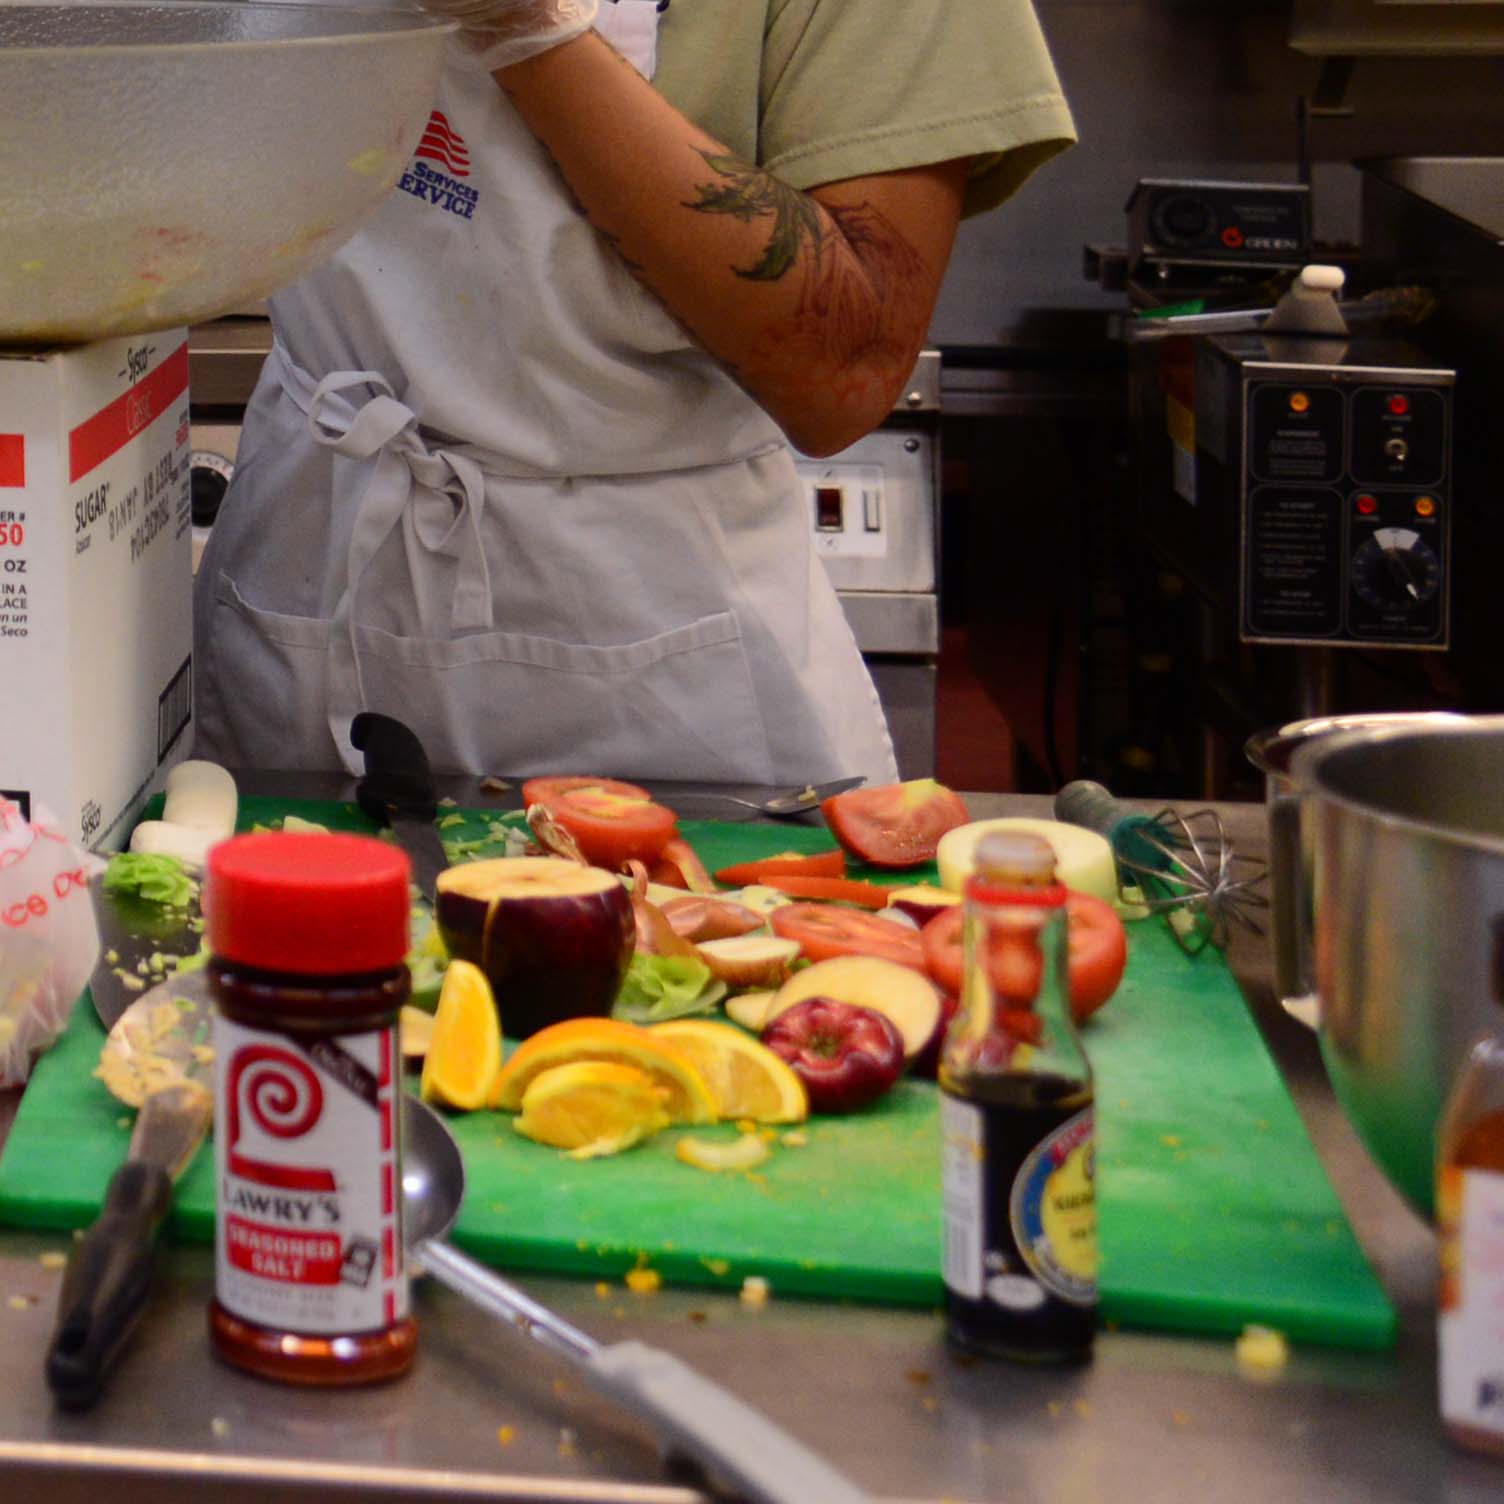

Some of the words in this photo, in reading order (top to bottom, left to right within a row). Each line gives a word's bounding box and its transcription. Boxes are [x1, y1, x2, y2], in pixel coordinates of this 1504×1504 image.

[396, 172, 479, 221] ERVICE
[74, 481, 108, 533] SUGAR
[4, 559, 27, 573] OZ
[1, 583, 15, 595] IN
[18, 584, 27, 595] A
[0, 625, 28, 637] Seco
[12, 613, 28, 623] un
[223, 1176, 341, 1223] LAWRY'S
[228, 1222, 338, 1260] SEASONED
[250, 1250, 307, 1280] SALT
